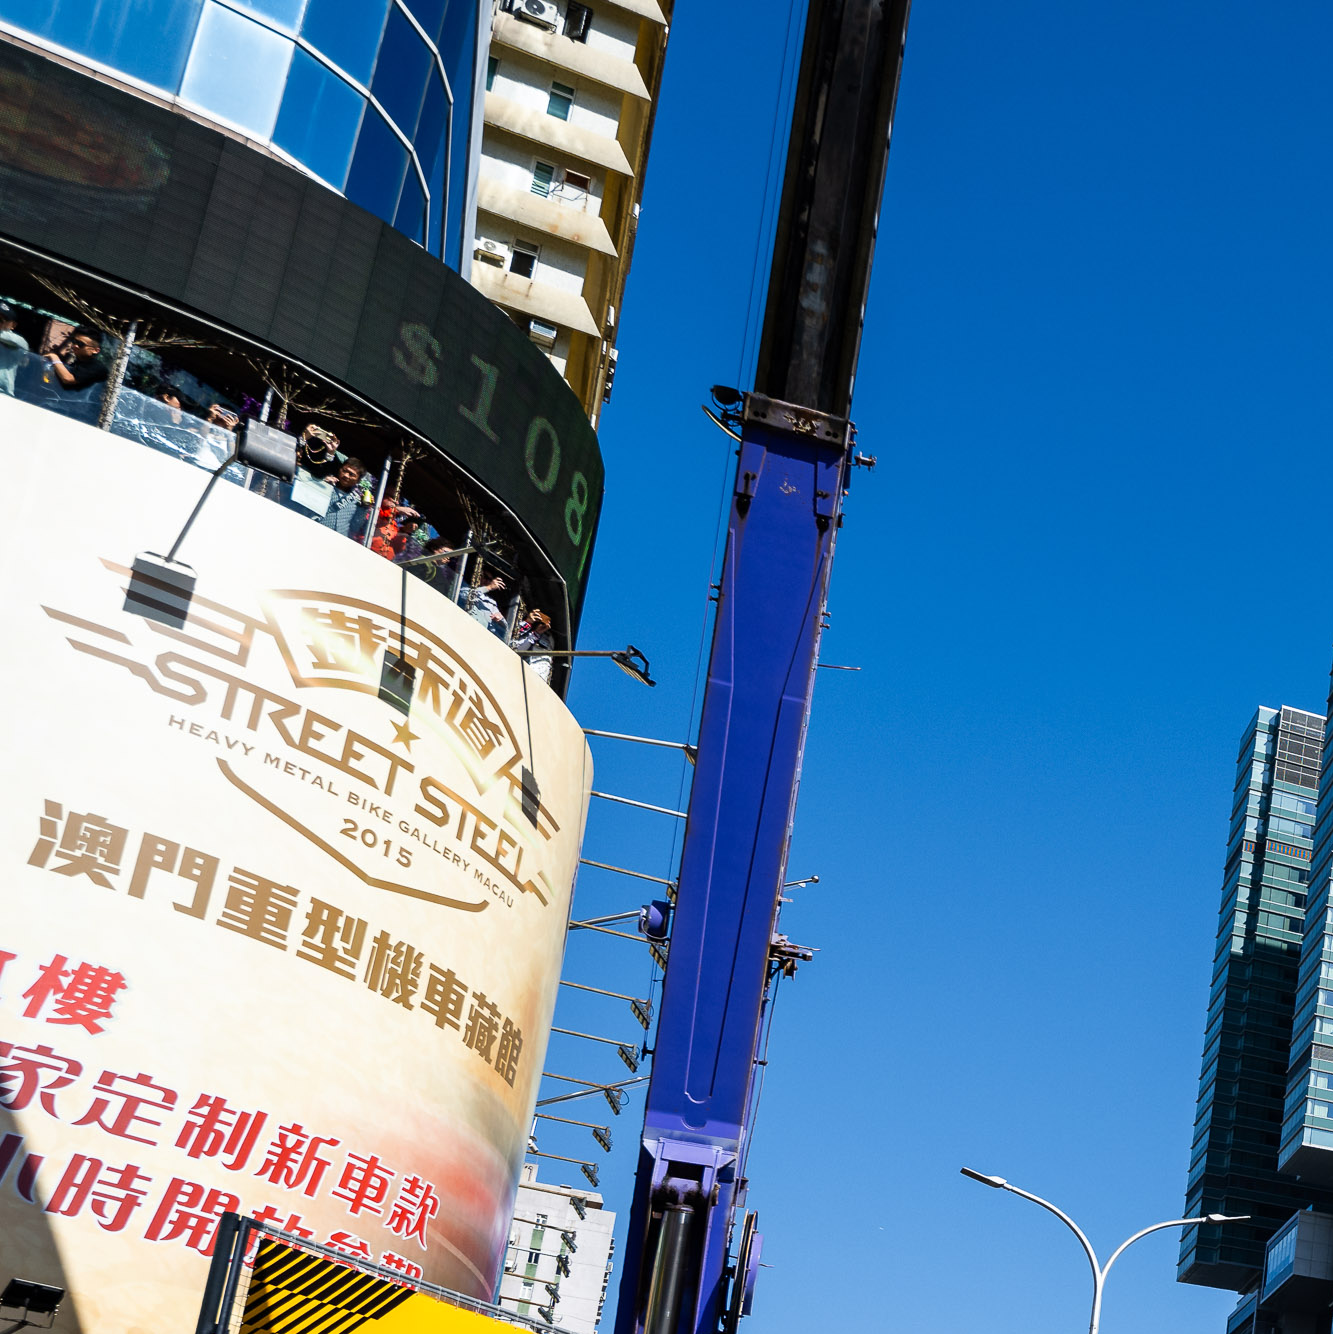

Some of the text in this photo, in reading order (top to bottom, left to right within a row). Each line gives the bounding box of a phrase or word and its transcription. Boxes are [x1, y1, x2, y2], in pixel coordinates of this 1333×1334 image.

[150, 650, 540, 894] STREET STEEL
[168, 714, 515, 909] HEAVY METAL BIKE GALLERY MACAU
[339, 818, 414, 869] 2015
[26, 798, 523, 1089] 澳門重型機車藏館
